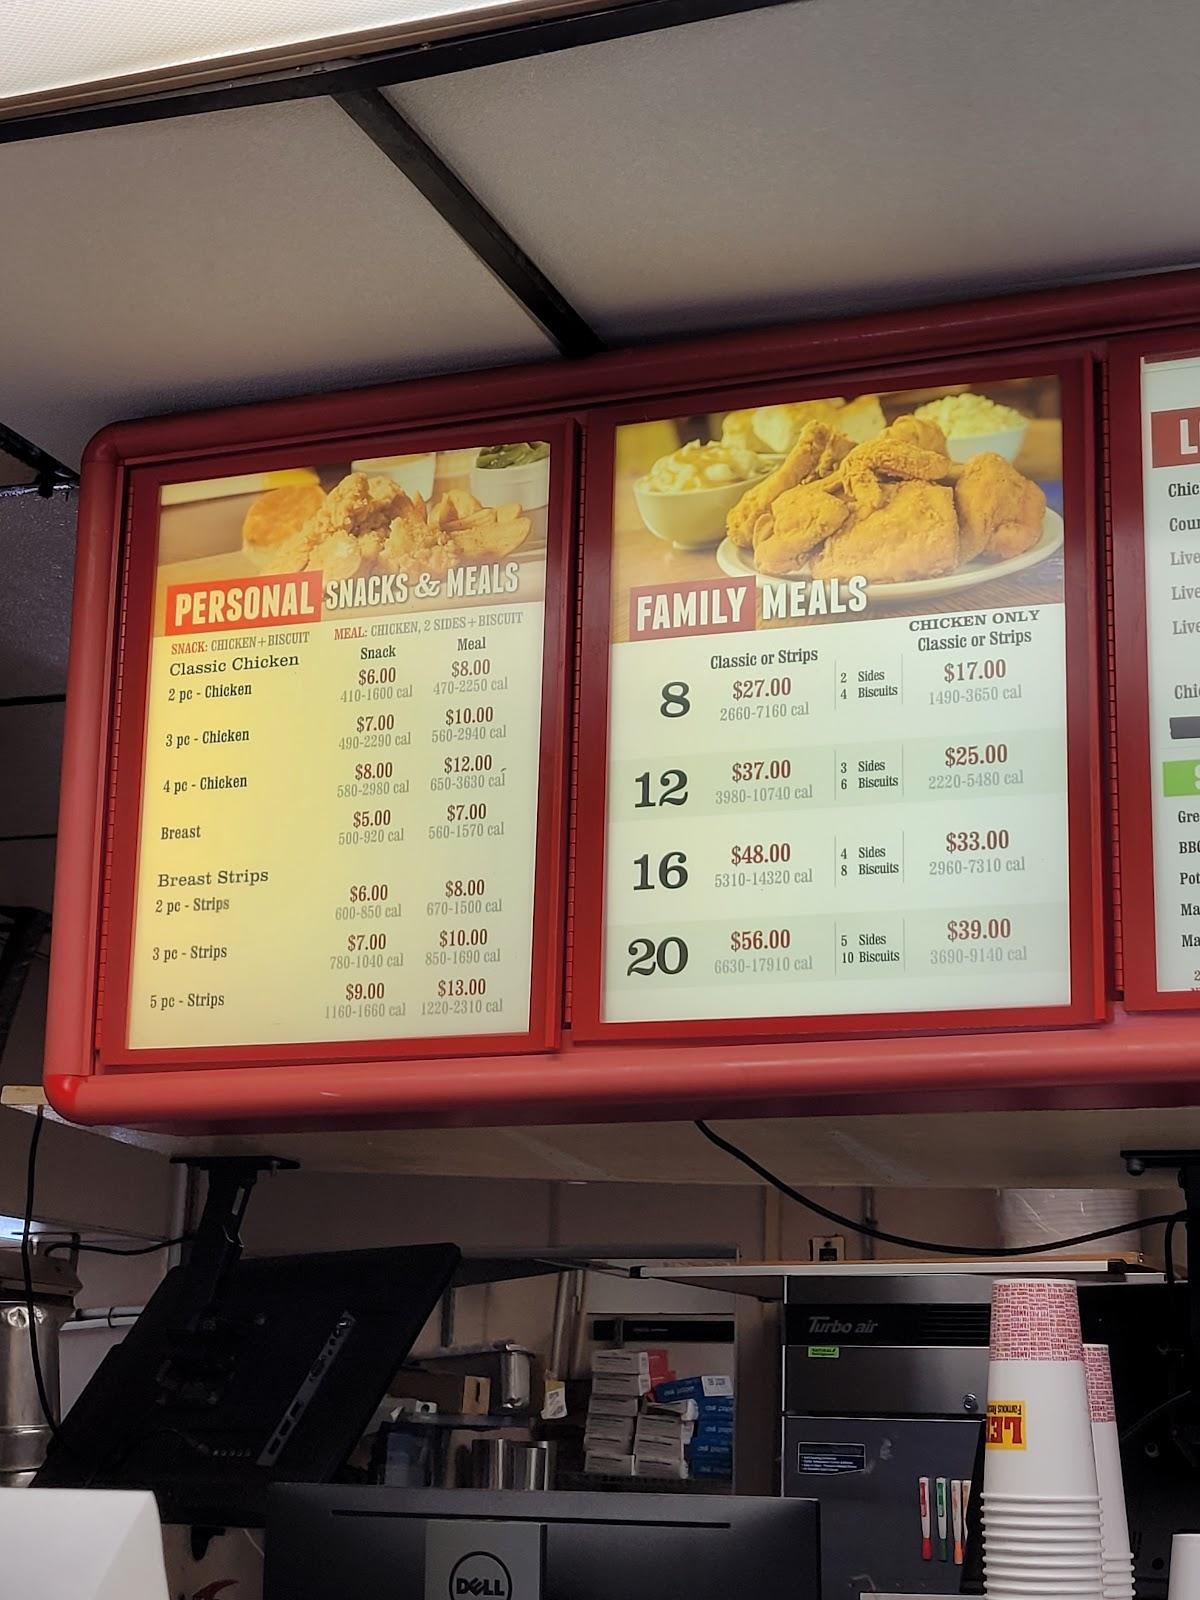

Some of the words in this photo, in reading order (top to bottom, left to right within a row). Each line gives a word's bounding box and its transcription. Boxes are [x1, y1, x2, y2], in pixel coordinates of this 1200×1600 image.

[175, 581, 314, 626] PERSONAL
[325, 574, 408, 611] SNACKS
[414, 572, 440, 597] &
[447, 562, 519, 596] MEALS
[636, 587, 747, 632] FAMILY
[762, 576, 867, 620] MEALS
[334, 627, 367, 640] MEAL:
[371, 621, 421, 637] CHICKEN,
[424, 620, 430, 632] 2
[909, 615, 986, 632] CHICKEN
[992, 610, 1040, 623] ONLY
[171, 641, 208, 655] SNACK:
[457, 637, 486, 651] Meal
[918, 635, 967, 651] Classic
[971, 635, 986, 646] or
[989, 630, 1032, 647] Strips
[360, 645, 396, 660] Snack
[710, 653, 757, 669] Classic
[761, 653, 774, 664] or
[778, 648, 818, 664] Strips
[170, 660, 226, 676] Classic
[232, 655, 299, 671] Chicken
[451, 659, 490, 678] $8.00
[944, 659, 1006, 683] $17.00
[358, 667, 396, 686] $6.00
[491, 677, 508, 690] cal
[840, 673, 847, 683] 2
[858, 670, 885, 682] Sides
[168, 689, 175, 701] 2
[179, 690, 193, 703] pc
[205, 684, 252, 698] Chicken
[396, 684, 413, 698] cal
[732, 677, 792, 701] $27.00
[840, 689, 847, 699] 4
[858, 685, 898, 698] Biscuits
[1003, 684, 1022, 699] cal
[660, 682, 691, 717] 8
[445, 706, 494, 726] $10.00
[720, 704, 787, 722] 2660-7160
[791, 702, 809, 717] cal
[357, 714, 395, 733] $7.00
[489, 725, 506, 738] cal
[166, 734, 173, 747] 3
[177, 735, 190, 749] pc
[202, 729, 249, 744] Chicken
[395, 732, 411, 746] cal
[444, 754, 492, 774] $12.00
[945, 743, 1008, 768] $25.00
[355, 762, 393, 781] $8.00
[732, 760, 791, 783] $37.00
[840, 763, 847, 773] 3
[858, 760, 885, 772] Sides
[163, 780, 170, 793] 4
[174, 781, 187, 795] pc
[200, 776, 247, 790] Chicken
[393, 780, 410, 793] cal
[488, 773, 505, 787] cal
[840, 779, 847, 790] 6
[858, 775, 899, 789] Biscuits
[1004, 770, 1024, 784] cal
[634, 769, 688, 808] 12
[715, 786, 790, 805] 3980-10740
[794, 784, 813, 799] cal
[353, 809, 391, 828] $5.00
[447, 803, 487, 822] $7.00
[161, 825, 201, 840] Breast
[388, 828, 404, 842] cal
[487, 821, 504, 836] cal
[946, 830, 1009, 854] $33.00
[731, 843, 791, 867] $48.00
[841, 848, 848, 859] 4
[858, 846, 886, 858] Sides
[633, 852, 689, 890] 16
[841, 865, 848, 876] 8
[858, 862, 899, 875] Biscuits
[1006, 856, 1026, 871] cal
[158, 872, 212, 887] Breast
[217, 869, 269, 886] Strips
[714, 870, 790, 888] 5310-14320
[794, 868, 813, 883] cal
[350, 884, 388, 903] $6.00
[445, 879, 485, 898] $8.00
[155, 900, 163, 913] 2
[167, 901, 180, 915] pc
[193, 897, 230, 913] Strips
[385, 904, 402, 918] cal
[485, 899, 502, 912] cal
[439, 928, 488, 948] $10.00
[947, 918, 1011, 942] $39.00
[348, 933, 386, 952] $7.00
[730, 929, 790, 952] $56.00
[841, 935, 848, 946] 5
[858, 934, 886, 945] Sides
[153, 947, 160, 960] 3
[164, 949, 178, 963] pc
[190, 945, 228, 961] Strips
[387, 953, 404, 967] cal
[483, 948, 500, 962] cal
[627, 936, 689, 976] 20
[842, 952, 854, 964] 10
[859, 950, 900, 962] Biscuits
[1007, 946, 1027, 961] cal
[714, 957, 790, 974] 6630-17910
[794, 955, 813, 970] cal
[346, 983, 385, 1001] $9.00
[438, 978, 486, 998] $13.00
[150, 994, 157, 1008] 5
[161, 996, 175, 1010] pc
[187, 993, 225, 1009] Strips
[389, 1002, 406, 1017] cal
[486, 998, 503, 1012] cal
[809, 1316, 852, 1333] Turbo
[855, 1319, 878, 1333] air
[986, 1416, 1022, 1444] LE
[456, 1579, 504, 1597] DELL
